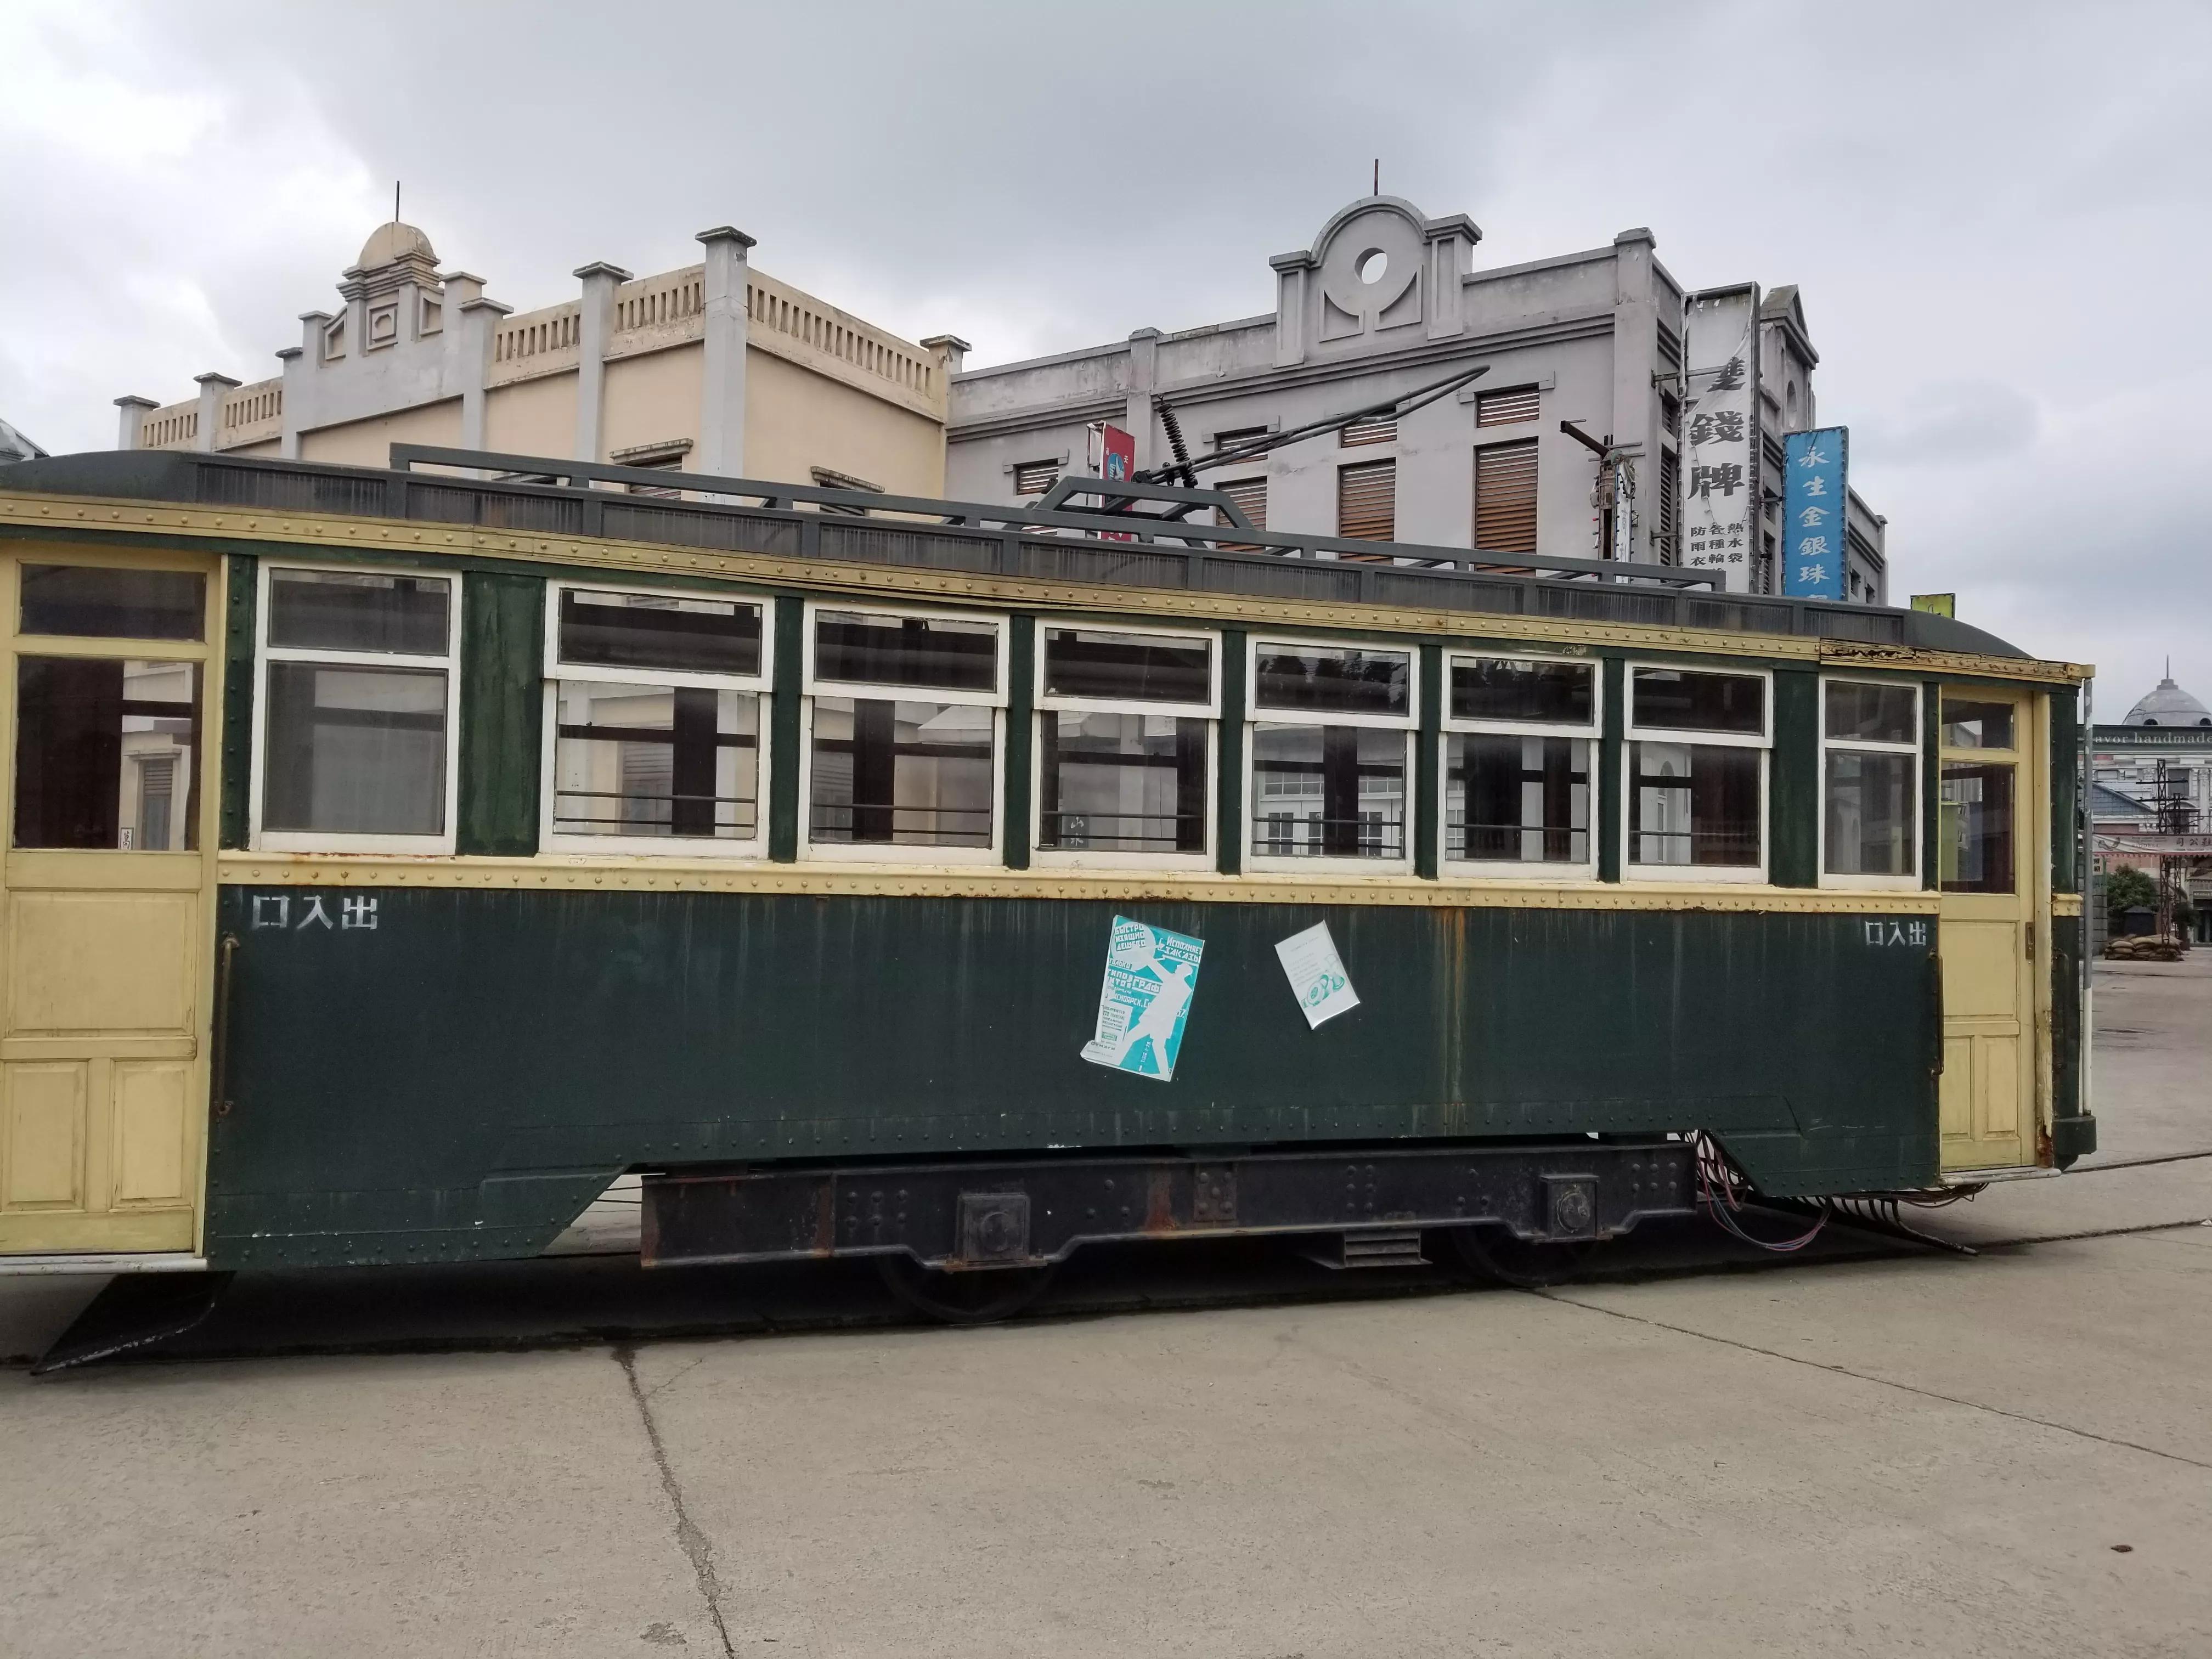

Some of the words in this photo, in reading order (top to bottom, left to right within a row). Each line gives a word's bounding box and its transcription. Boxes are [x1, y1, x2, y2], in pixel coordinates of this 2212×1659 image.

[1798, 445, 1830, 600] 永生金銀珠
[1690, 526, 1707, 566] 防雨衣
[1708, 522, 1725, 571] 各種輪
[2095, 735, 2129, 743] avor
[2134, 732, 2212, 744] handmade
